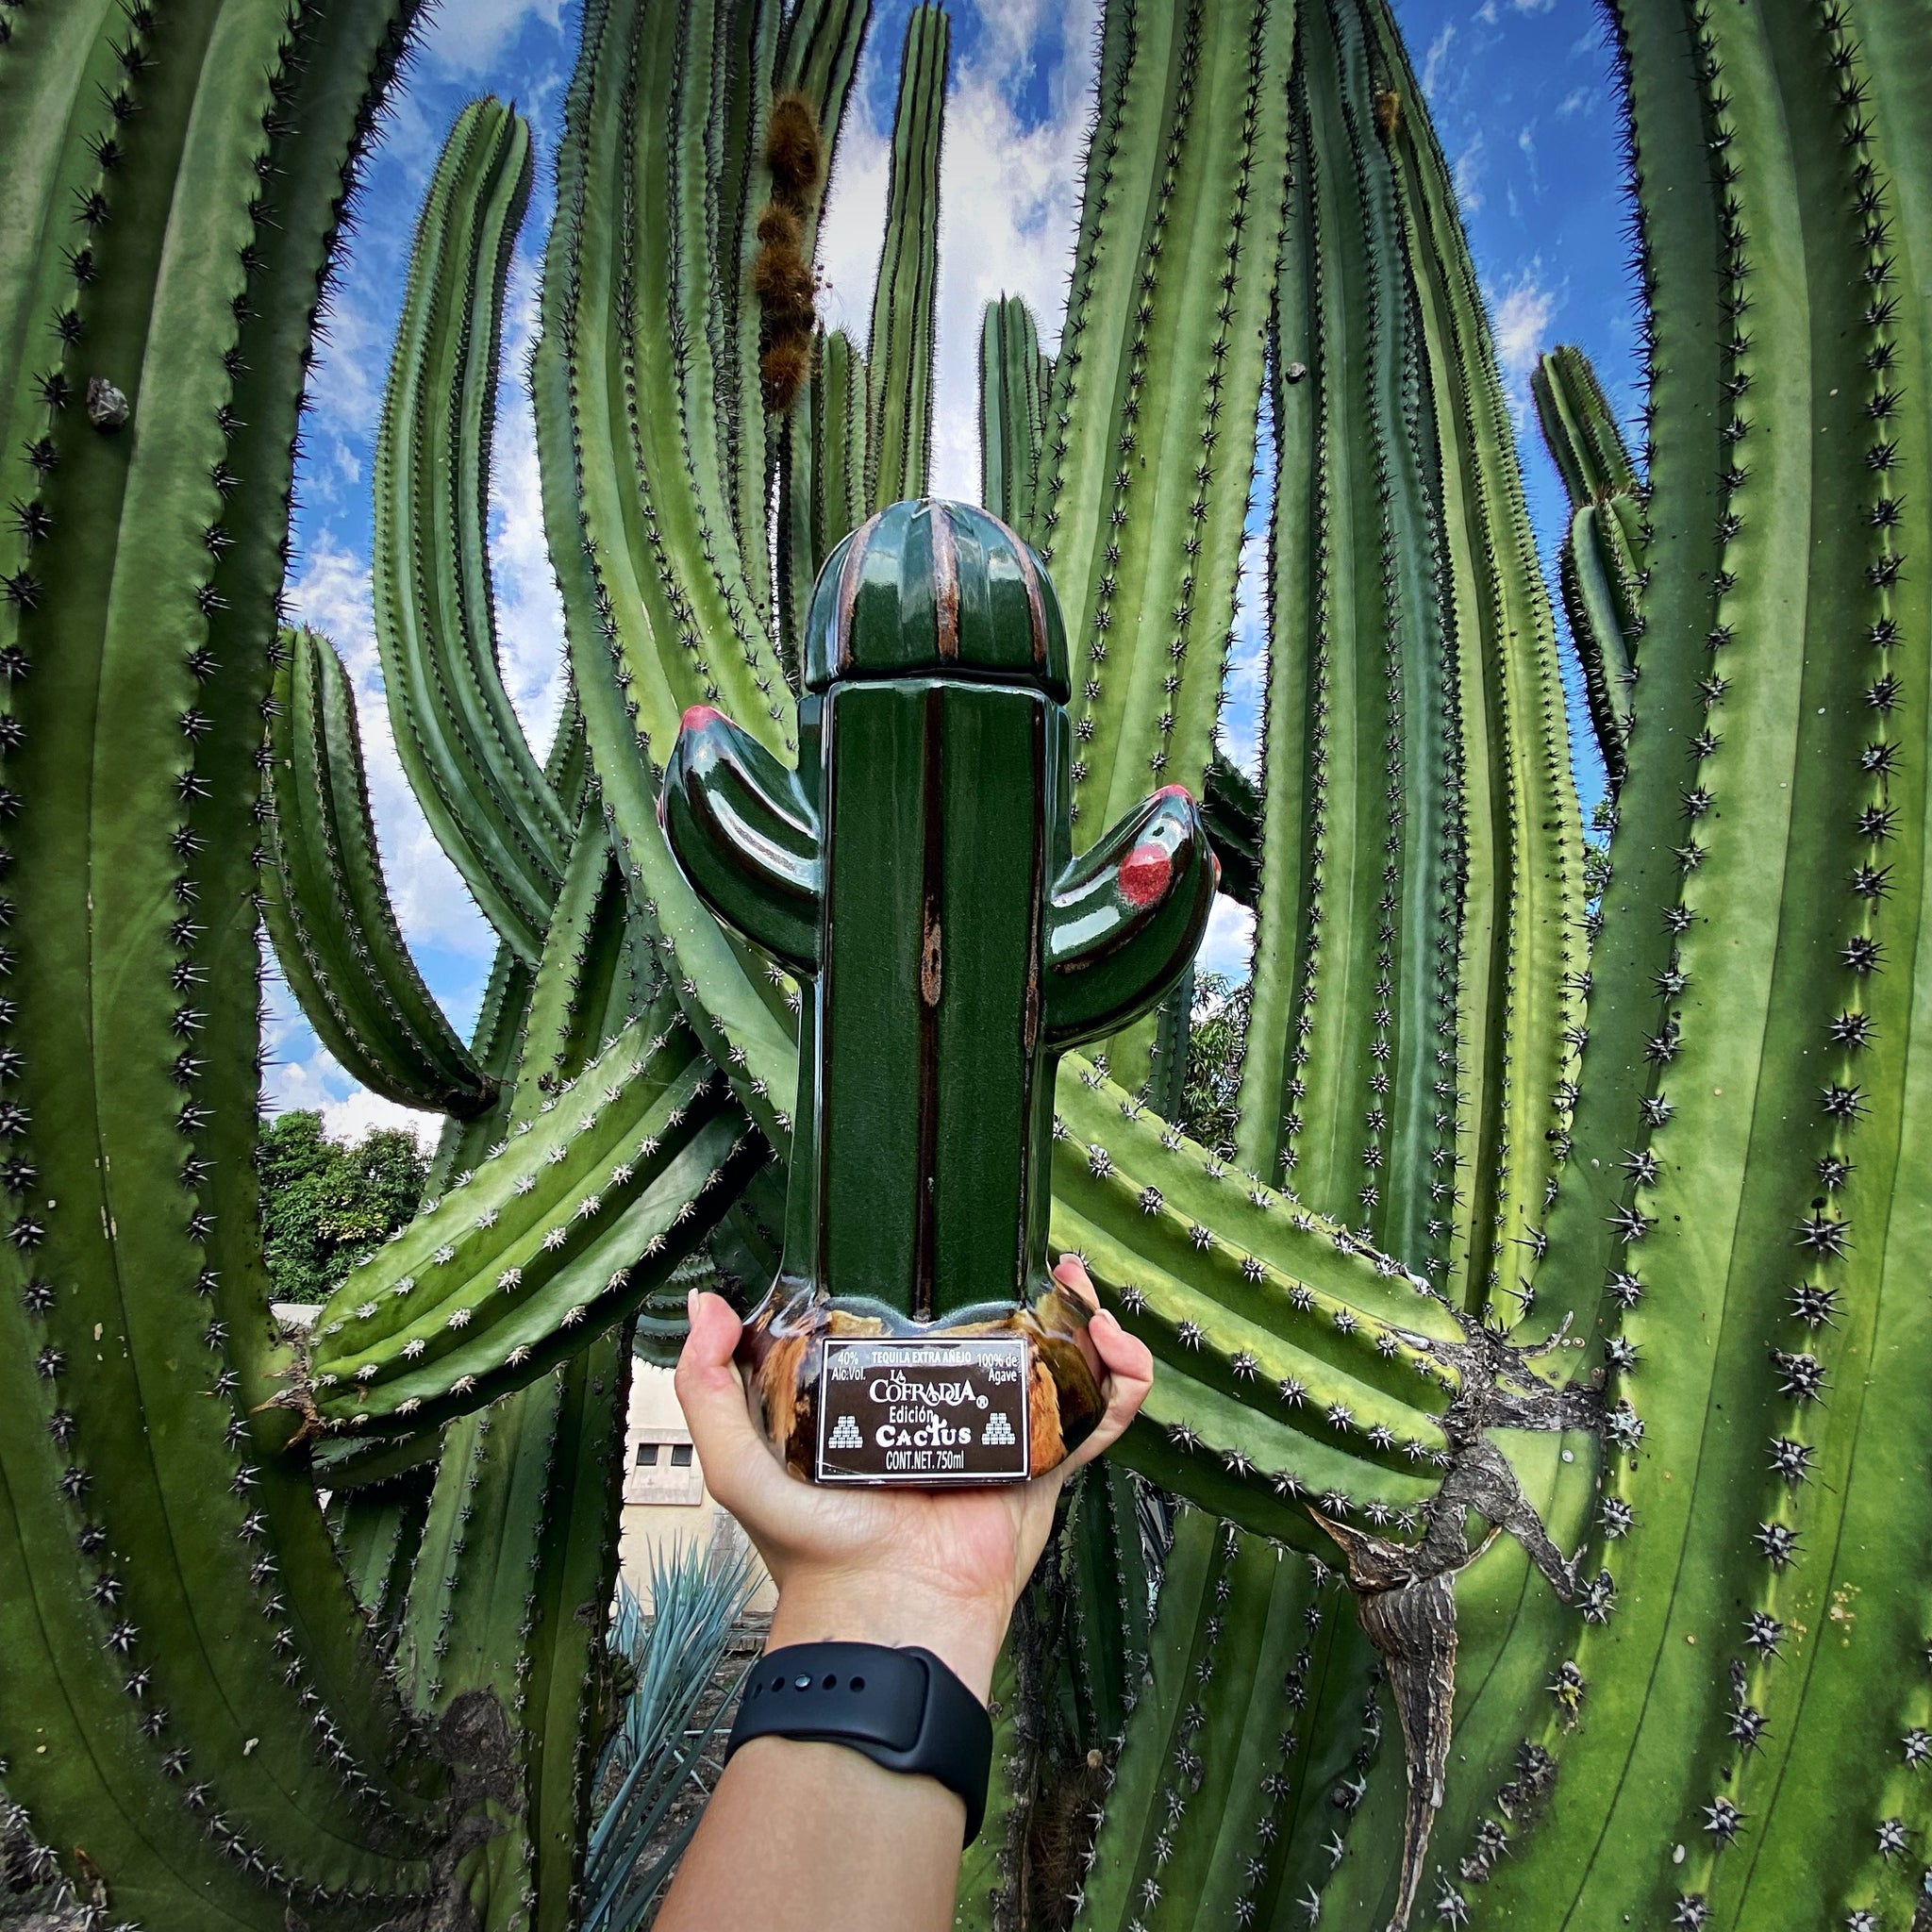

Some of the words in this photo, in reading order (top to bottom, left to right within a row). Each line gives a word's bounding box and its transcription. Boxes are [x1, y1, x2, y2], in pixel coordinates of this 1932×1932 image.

[838, 1352, 858, 1365] 40%
[872, 1351, 910, 1363] TEQUILA
[912, 1352, 942, 1363] EXTRA
[943, 1350, 972, 1363] AÑEJO
[977, 1354, 1004, 1367] 100%
[1006, 1354, 1018, 1367] de
[890, 1370, 906, 1383] LA
[989, 1370, 1017, 1385] Agave
[890, 1406, 934, 1423] Edición
[937, 1452, 964, 1469] 750ml
